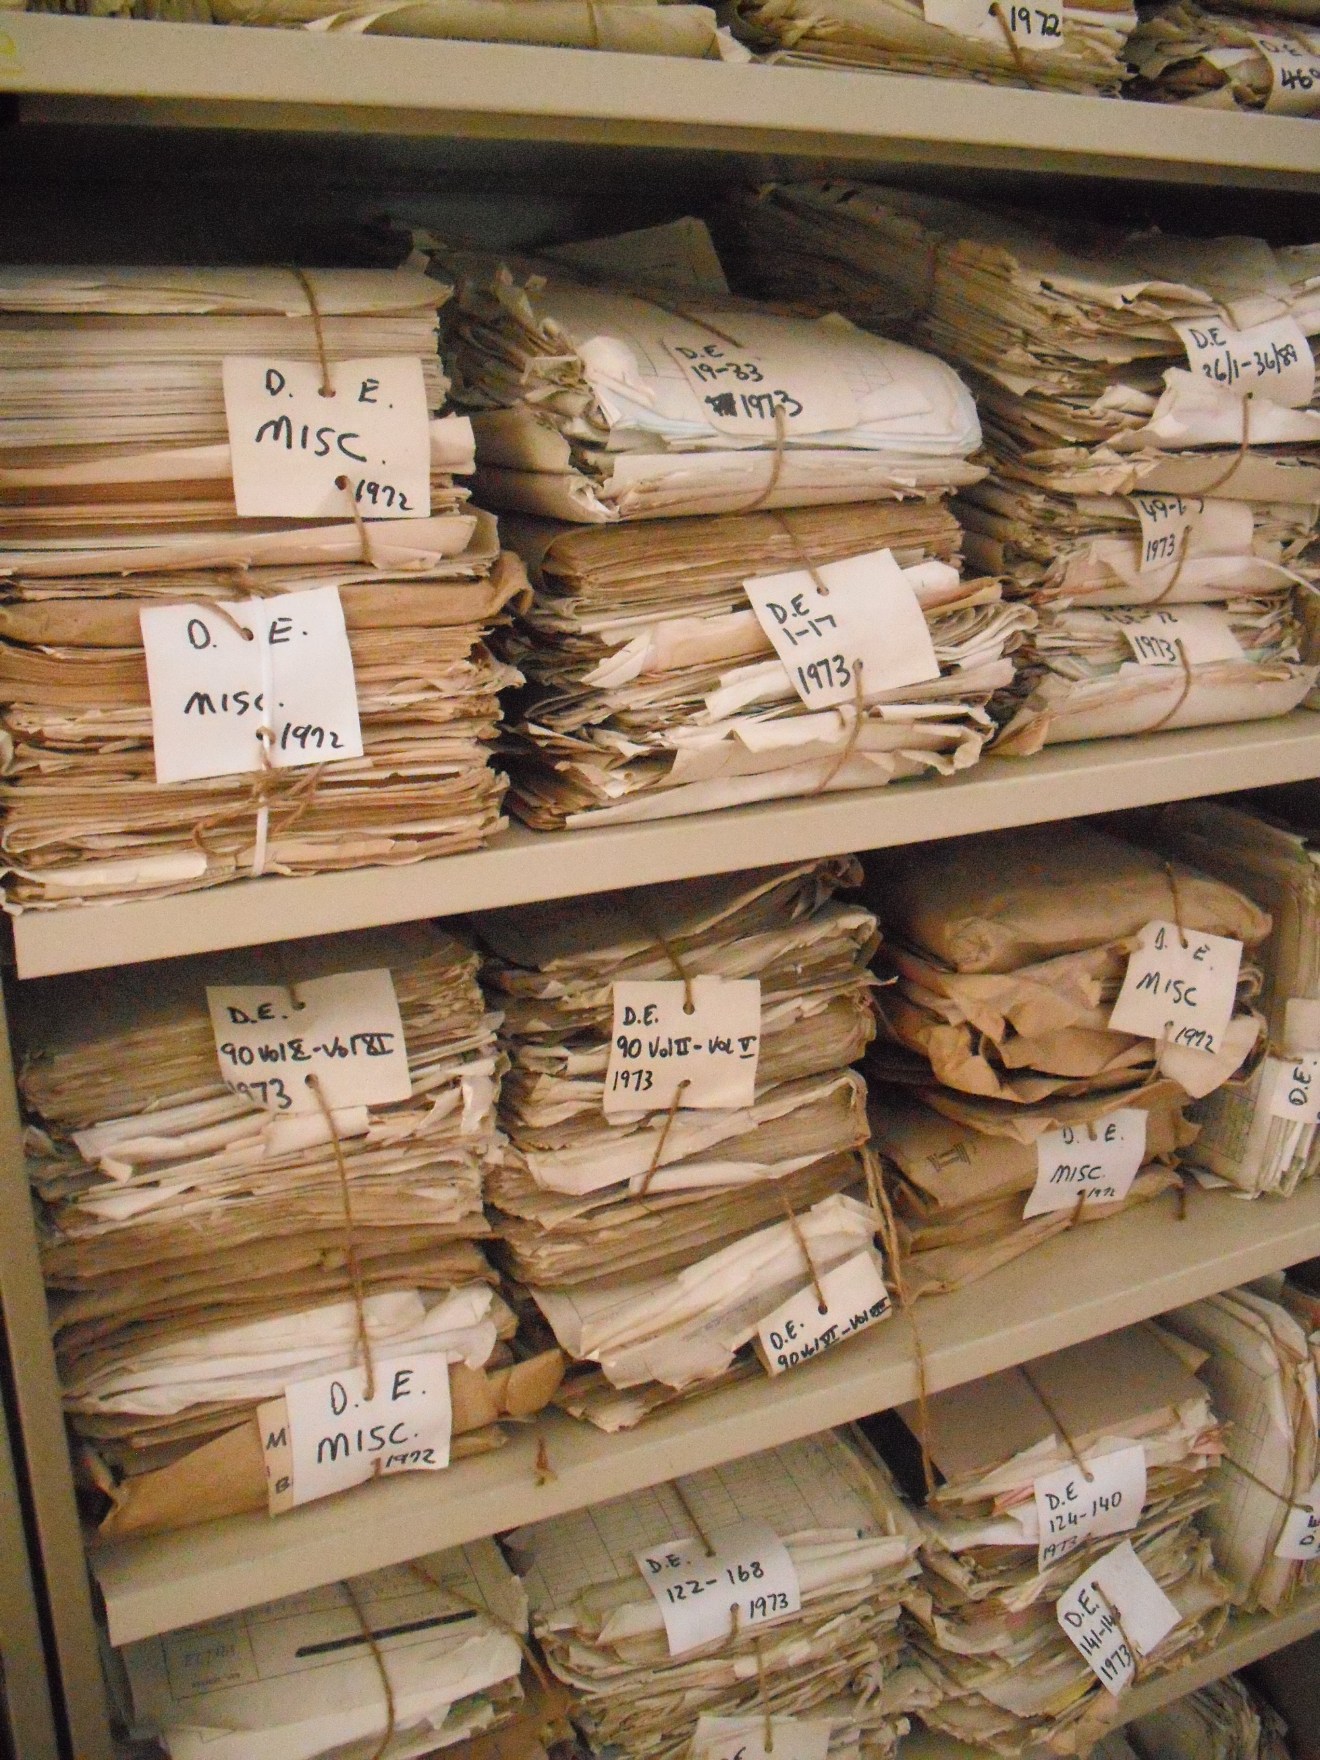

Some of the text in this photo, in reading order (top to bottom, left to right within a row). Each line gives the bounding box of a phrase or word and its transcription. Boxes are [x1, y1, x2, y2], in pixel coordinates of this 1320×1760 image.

[1010, 5, 1061, 36] 1972
[740, 390, 803, 419] 1973
[355, 479, 414, 511] 1972
[1146, 533, 1176, 562] 1973
[1134, 636, 1177, 661] 1973
[797, 654, 850, 694] 1973
[281, 722, 344, 750] 1972
[1136, 972, 1198, 1007] MISC
[616, 1035, 642, 1059] 90
[1175, 1026, 1217, 1055] 1972
[612, 1069, 653, 1092] 1973
[385, 1448, 436, 1467] 1972
[749, 1593, 789, 1619] 1973
[1101, 1644, 1131, 1681] 1973
